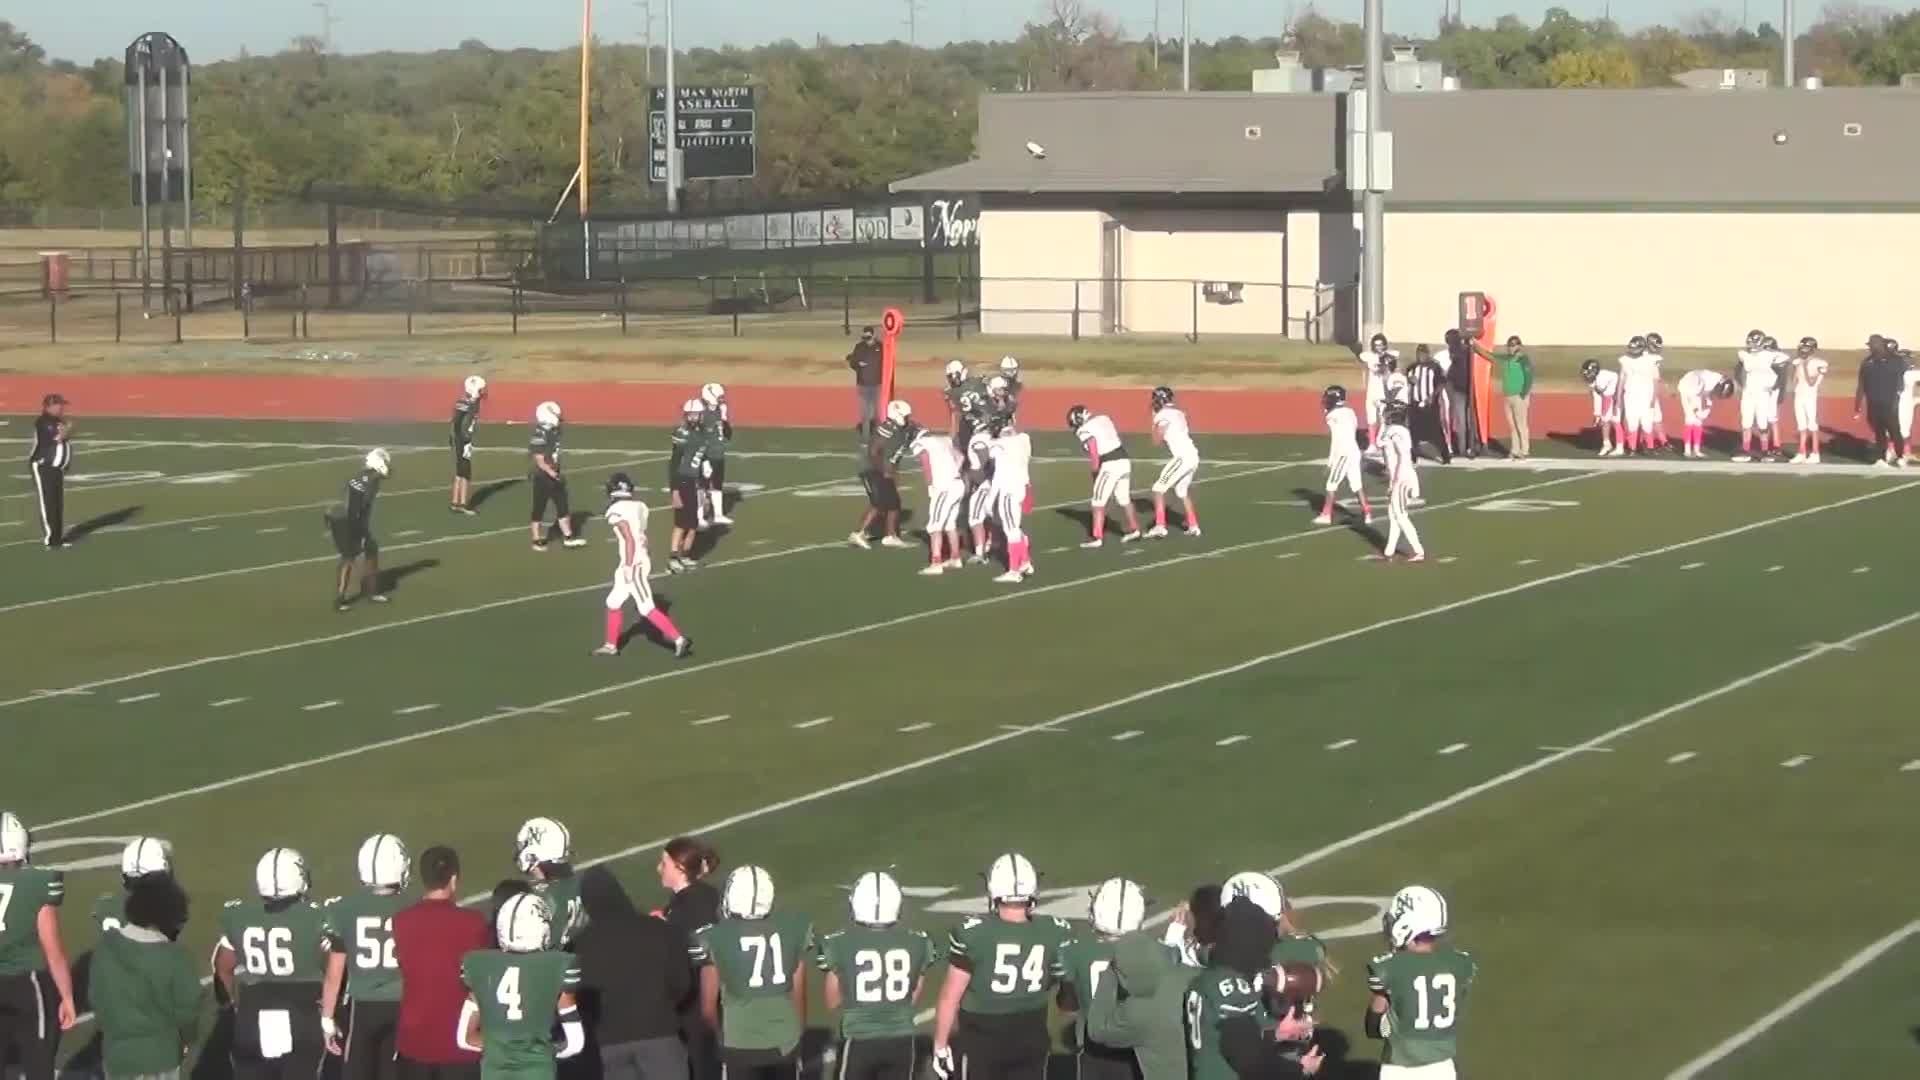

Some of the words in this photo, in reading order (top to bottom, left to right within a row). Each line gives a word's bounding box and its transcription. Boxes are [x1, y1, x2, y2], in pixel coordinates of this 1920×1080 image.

[671, 98, 738, 110] ASEBALL
[1464, 296, 1477, 320] 1
[242, 926, 294, 975] 66
[740, 933, 786, 988] 71
[855, 949, 911, 1002] 28
[990, 943, 1044, 994] 54
[496, 966, 522, 1020] 4
[1413, 973, 1456, 1030] 13
